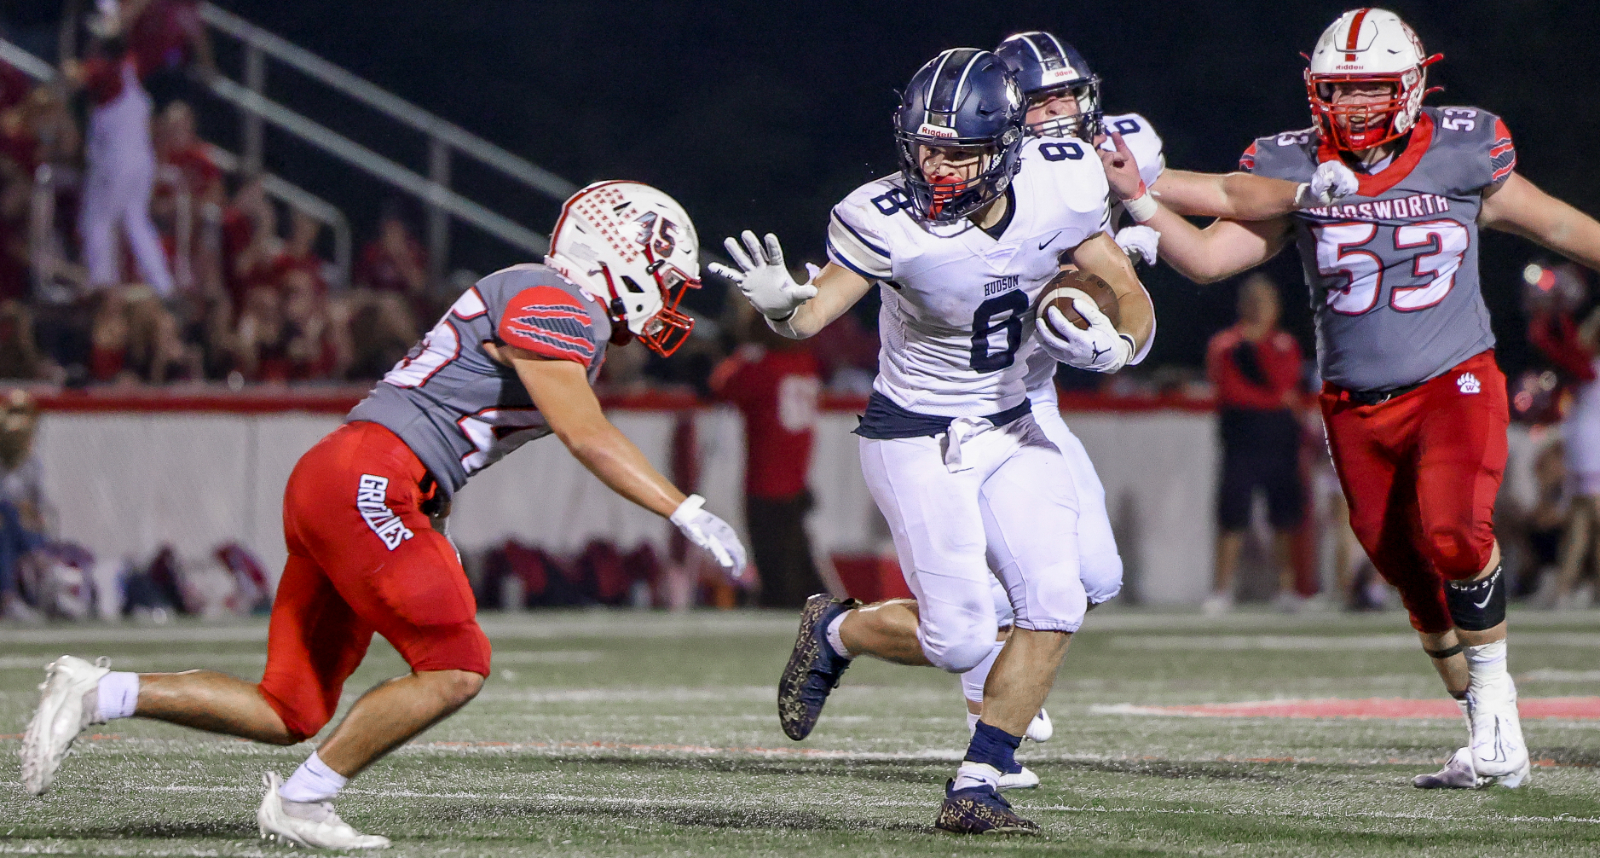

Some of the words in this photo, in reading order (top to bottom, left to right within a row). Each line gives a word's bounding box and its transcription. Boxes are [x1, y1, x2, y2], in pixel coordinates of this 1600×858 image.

[1442, 107, 1477, 132] 53
[1038, 142, 1084, 162] 8
[1311, 218, 1470, 316] 53
[984, 275, 1019, 296] HUDSON
[357, 473, 414, 551] GRIZZLIES
